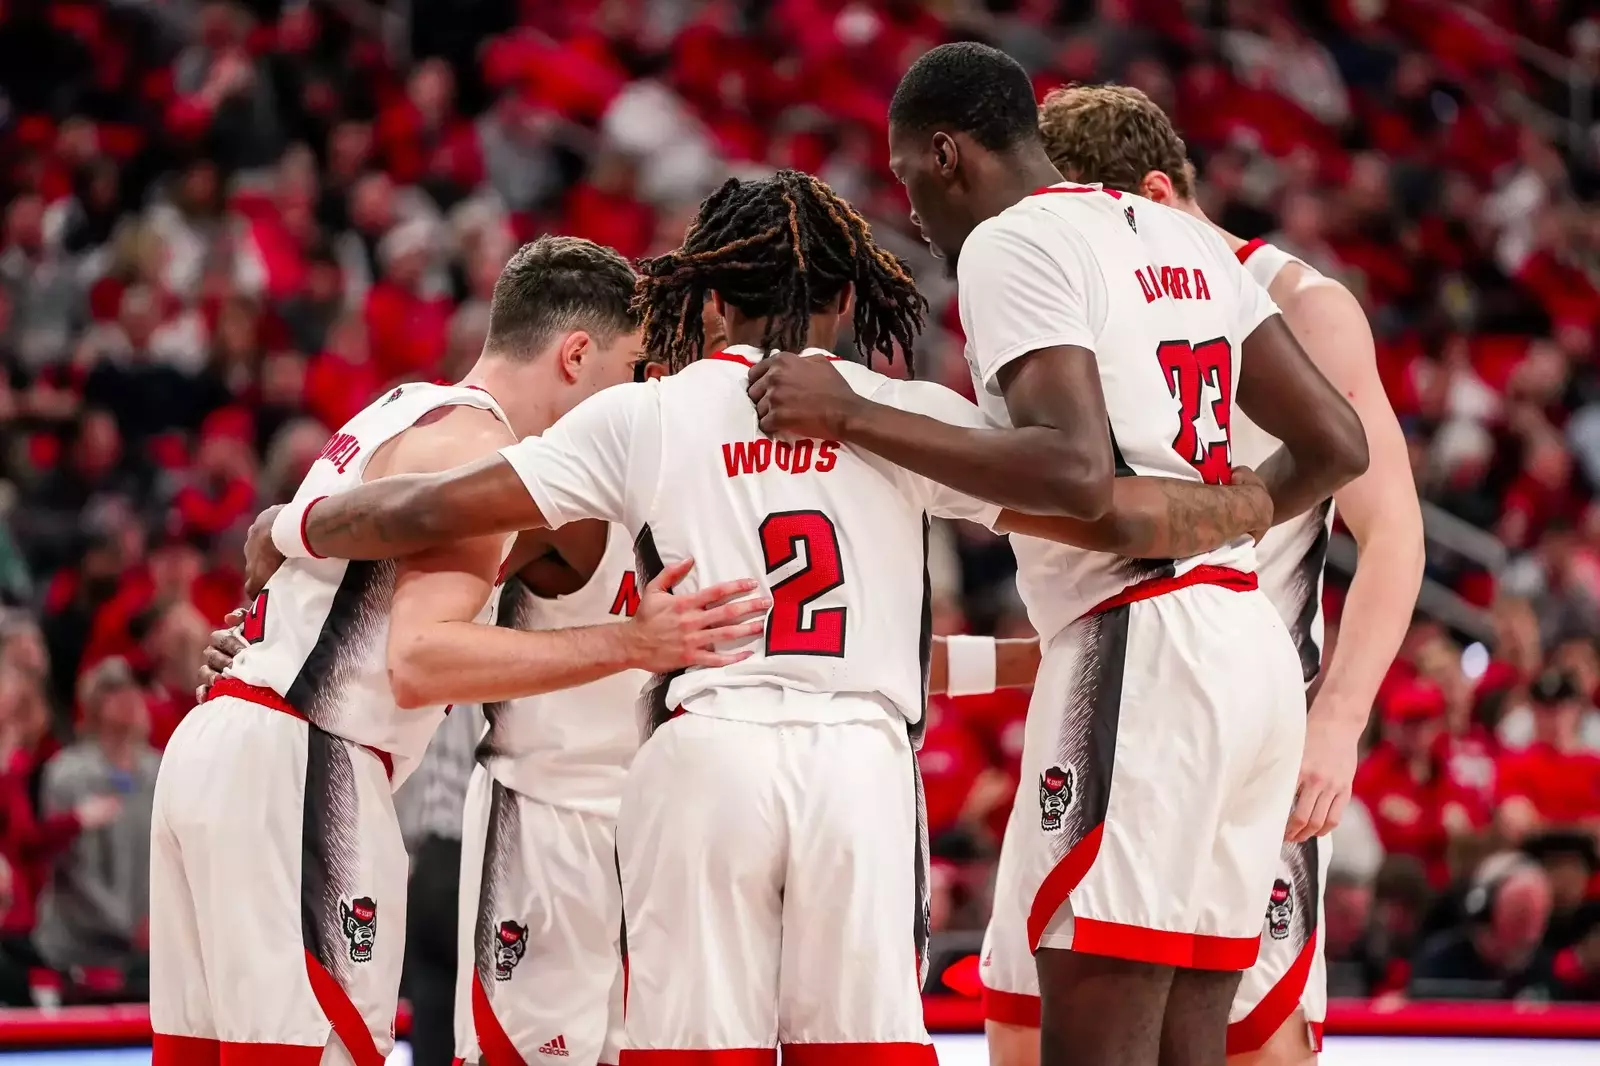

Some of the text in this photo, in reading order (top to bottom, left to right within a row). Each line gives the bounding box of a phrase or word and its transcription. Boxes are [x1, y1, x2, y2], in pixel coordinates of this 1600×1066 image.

[721, 438, 841, 478] WOODS
[758, 509, 847, 658] 2
[538, 1046, 570, 1057] adidas
